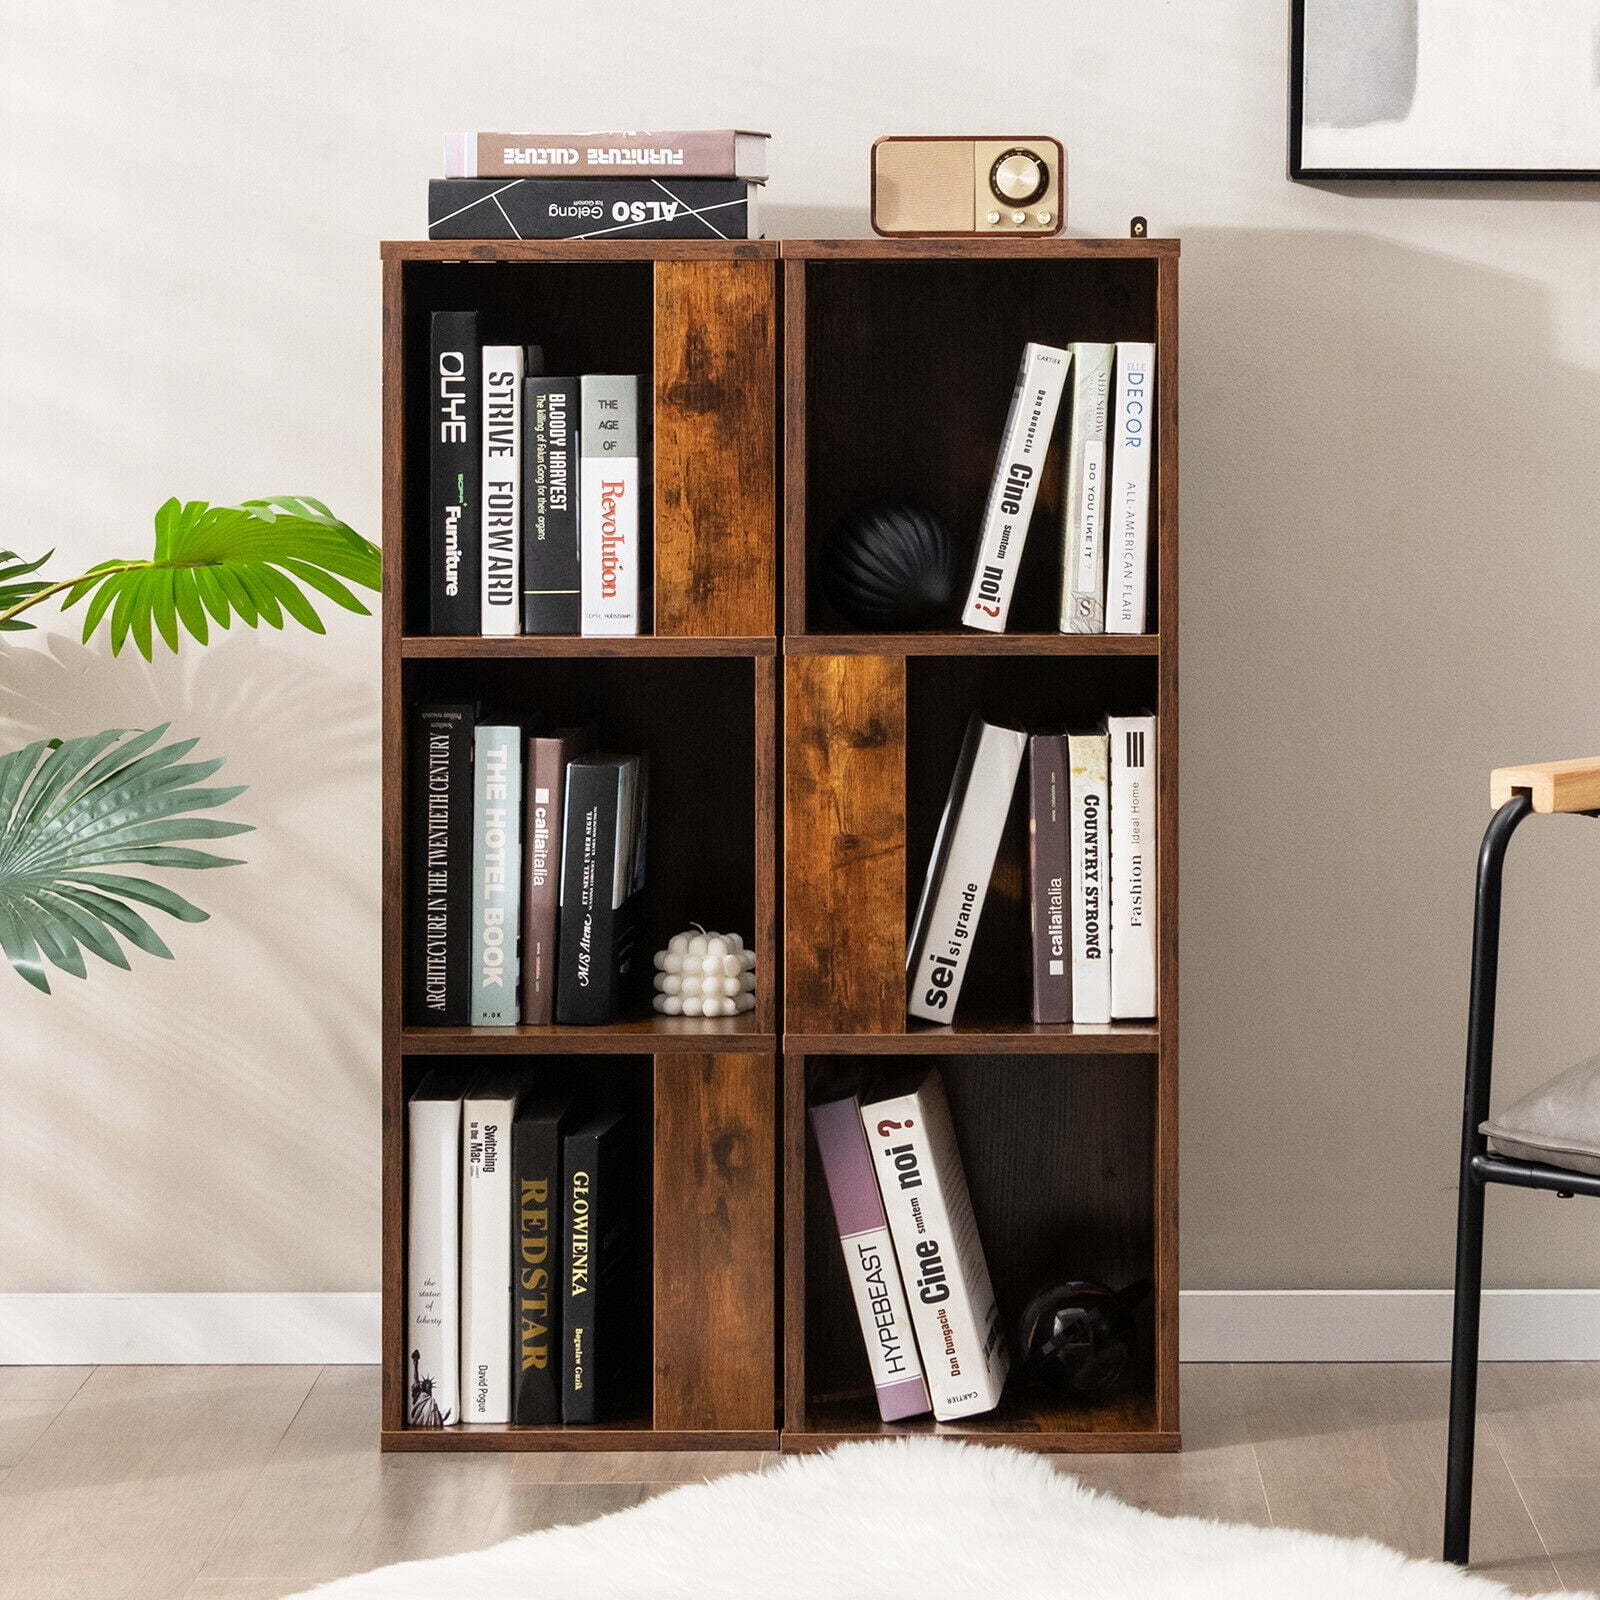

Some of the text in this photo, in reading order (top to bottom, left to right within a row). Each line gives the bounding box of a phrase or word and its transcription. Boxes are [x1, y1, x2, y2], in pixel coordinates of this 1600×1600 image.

[504, 148, 579, 164] CULTURE
[548, 201, 678, 221] ALSO Gelang
[598, 400, 618, 409] THE
[599, 421, 619, 430] AGE
[1024, 390, 1046, 454] Dan Dungaciu
[1096, 372, 1106, 434] SIDESHOW
[1126, 373, 1144, 447] DECOR
[535, 395, 546, 540] The killing of Falun Gong for their organs
[549, 394, 566, 511] BLOODY HARVEST
[603, 441, 617, 450] OF
[1088, 463, 1097, 480] DO
[488, 372, 514, 606] STRIVE FORWARD
[1001, 464, 1033, 515] Cine
[1087, 486, 1095, 511] YOU
[445, 506, 462, 596] Furniture
[601, 480, 625, 598] Revolution
[997, 525, 1012, 559] suntem
[1084, 547, 1092, 559] IT
[1085, 515, 1093, 543] LIKE
[1121, 482, 1137, 621] ALL-AMERICAN FLAIR
[429, 733, 451, 791] CENTURY
[429, 794, 451, 868] TWENTIETH
[1131, 782, 1140, 844] Ideal Home
[483, 744, 508, 988] THE HOTEL BOOK
[533, 807, 549, 886] caliaitalia
[428, 870, 448, 895] THE
[428, 898, 447, 911] IN
[1084, 794, 1101, 960] COUNTRY STRONG
[1130, 855, 1142, 927] Fashion
[923, 882, 978, 1010] sei si grande
[1048, 878, 1064, 956] caliaitalia
[471, 1130, 479, 1139] the
[471, 1143, 482, 1163] Mac
[483, 1125, 497, 1173] Switching
[877, 1119, 914, 1137] ?
[885, 1143, 922, 1190] noi
[572, 1171, 589, 1296] GŁOWIENKA
[424, 1278, 436, 1286] the
[520, 1177, 548, 1371] REDSTAR
[915, 1240, 950, 1304] Cine
[416, 1315, 442, 1327] liberty
[857, 1241, 906, 1374] HYPEBEAST
[937, 1309, 961, 1377] Dan Dungaciu
[475, 1365, 488, 1413] David Pogue
[947, 1391, 978, 1404] CARTIER
